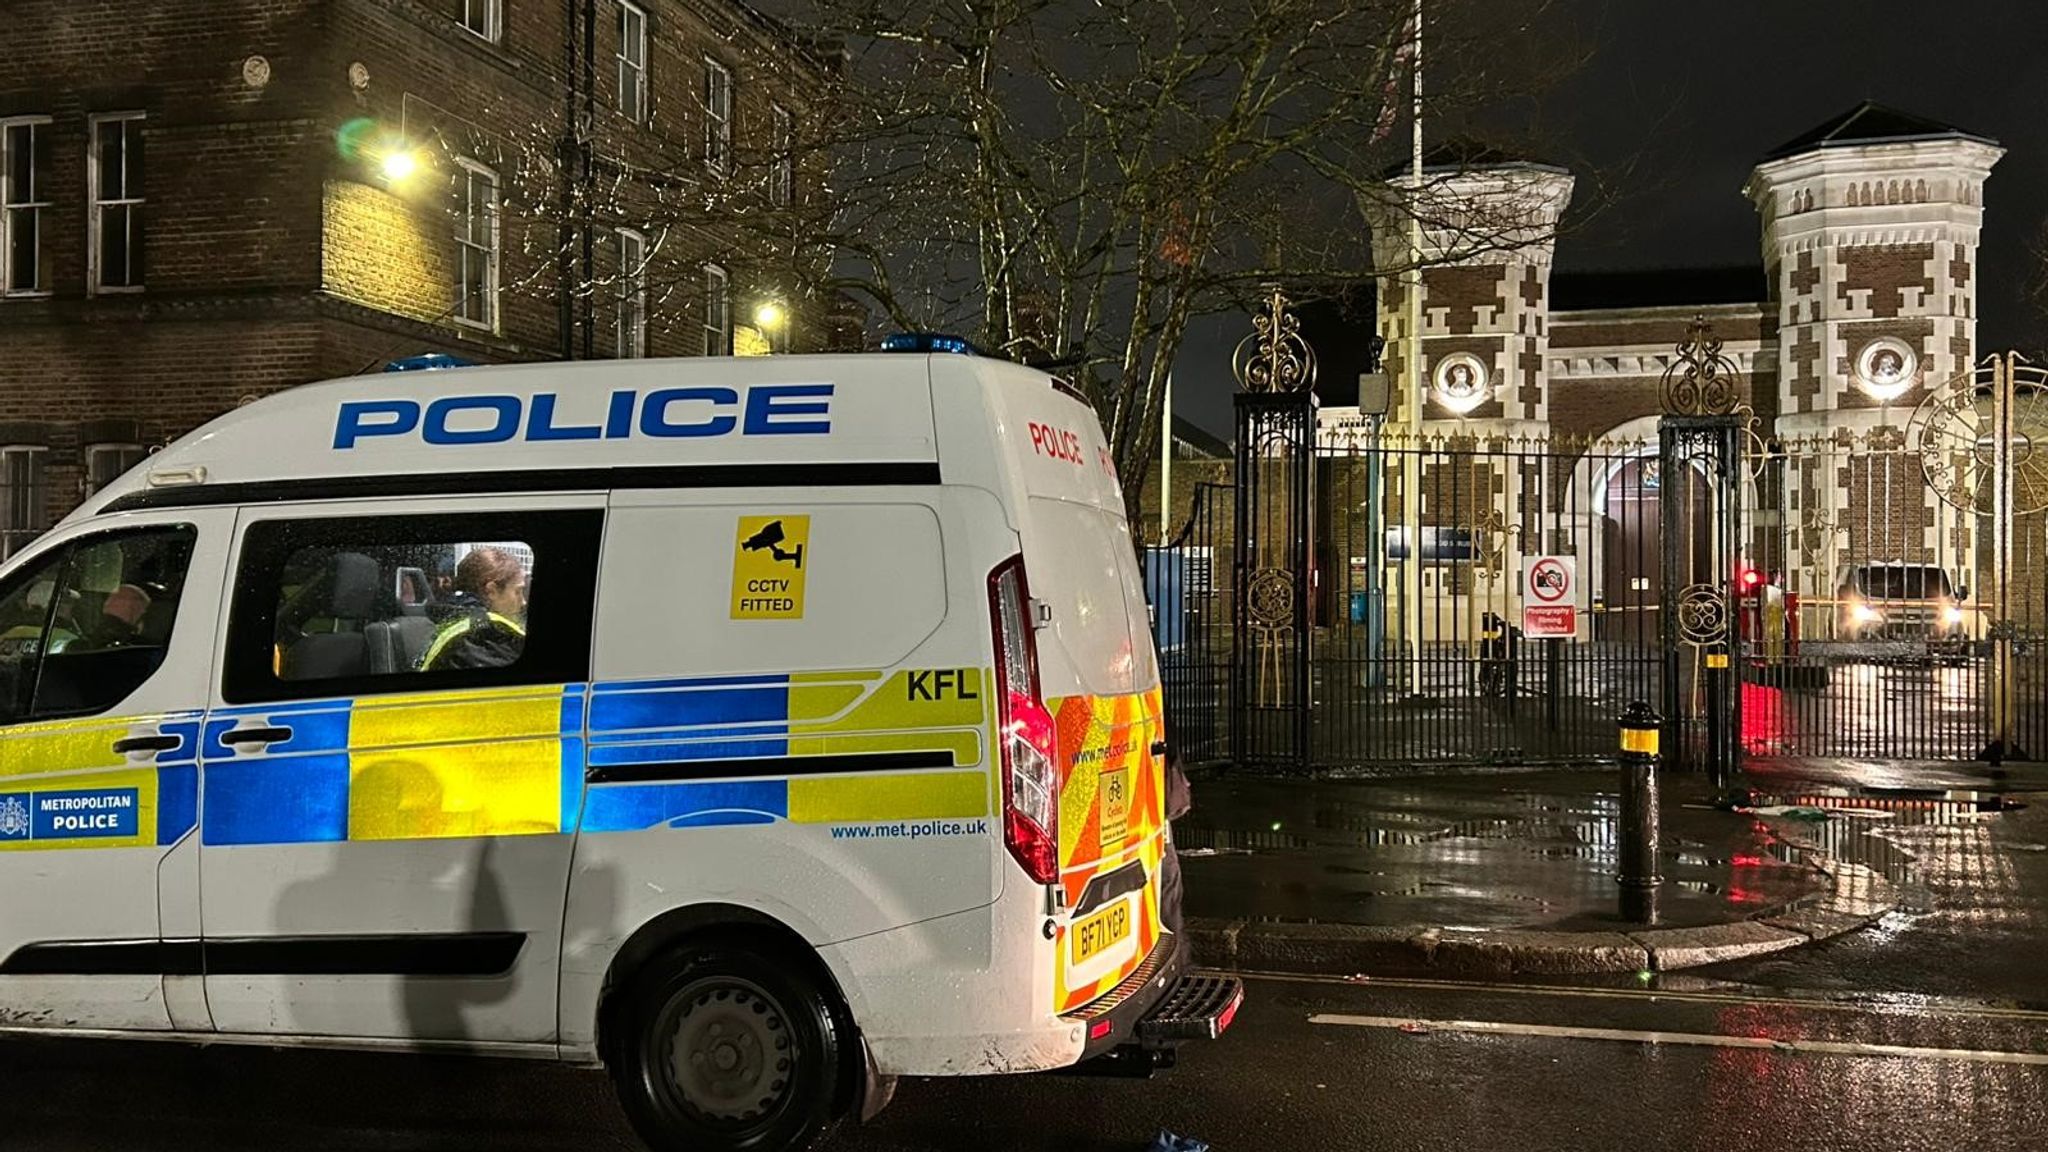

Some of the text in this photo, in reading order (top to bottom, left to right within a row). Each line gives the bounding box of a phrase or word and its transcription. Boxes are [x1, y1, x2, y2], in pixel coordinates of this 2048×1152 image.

[333, 384, 834, 449] POLICE
[1028, 422, 1083, 465] POLICE
[748, 580, 789, 592] CCTV
[741, 599, 793, 611] FITTED
[908, 670, 977, 701] KFL
[41, 796, 131, 811] METROPOLITAN
[53, 814, 118, 830] POLICE
[831, 820, 987, 839] www.met.police.uk
[1081, 917, 1105, 956] BF71
